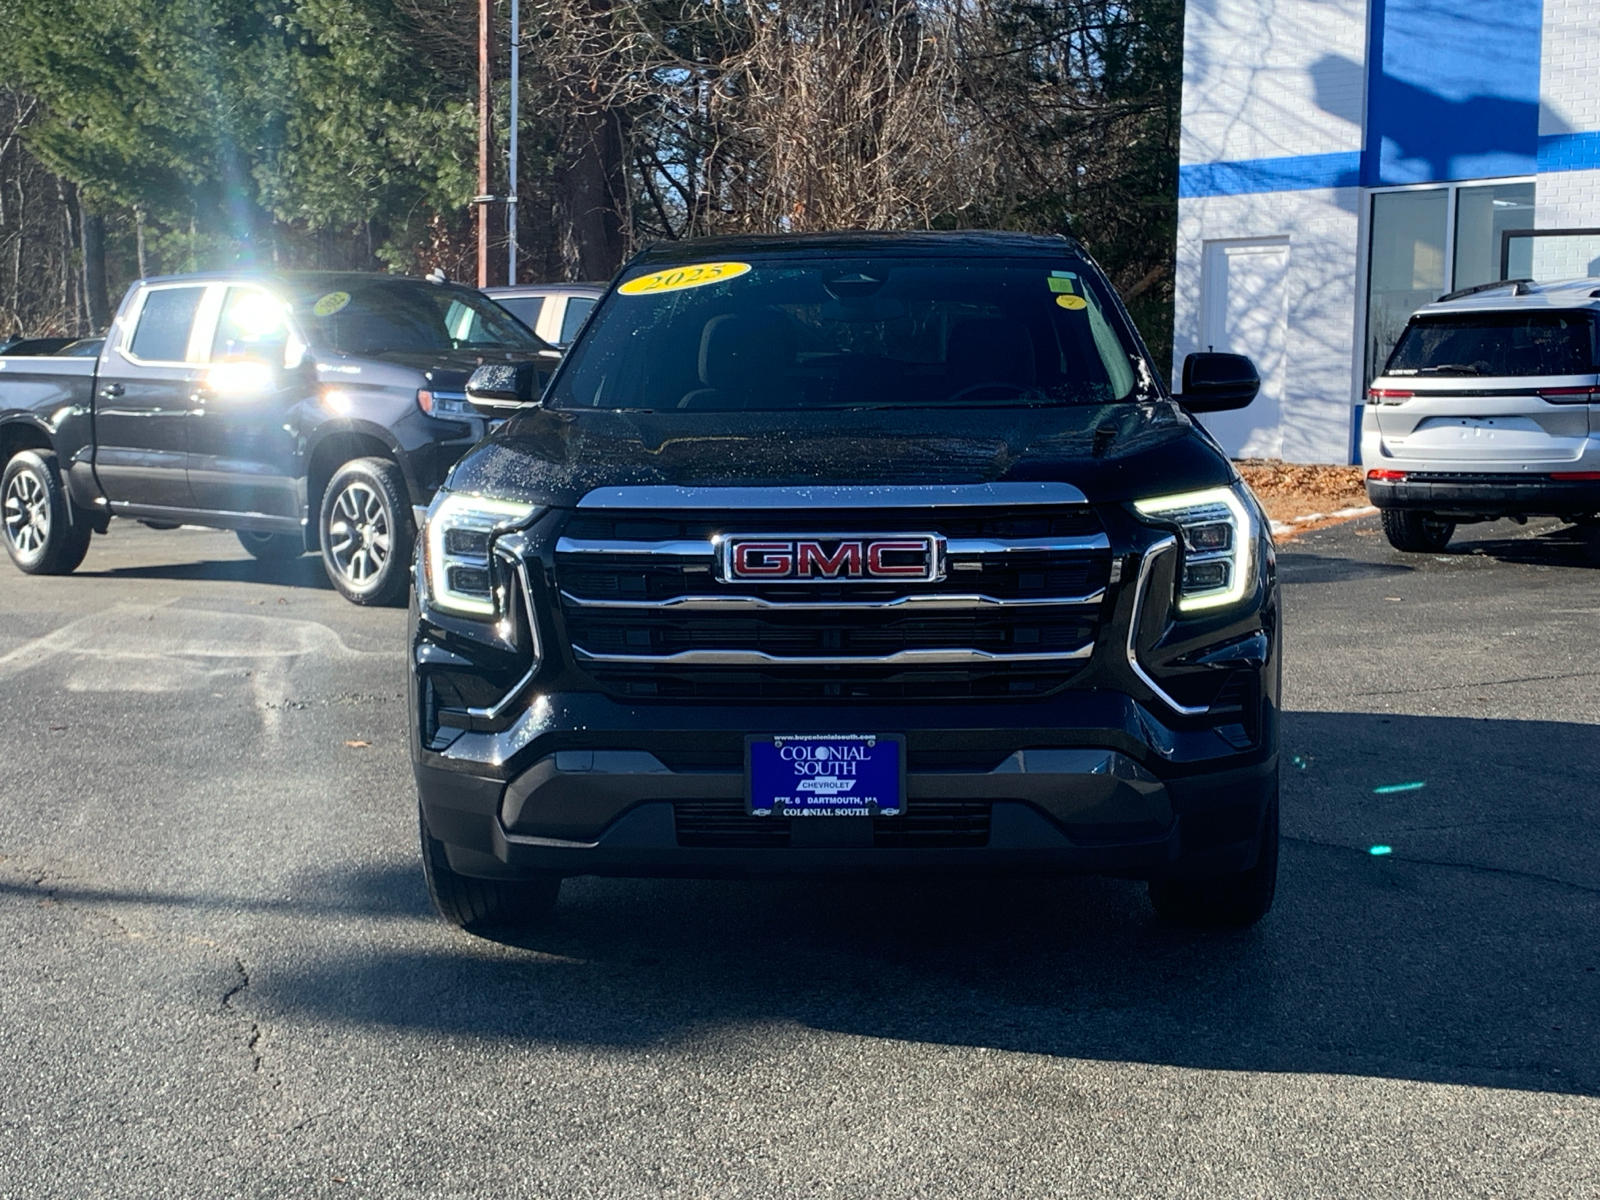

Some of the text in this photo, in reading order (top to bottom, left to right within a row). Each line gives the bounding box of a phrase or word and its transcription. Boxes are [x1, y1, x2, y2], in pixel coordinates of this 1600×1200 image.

[641, 263, 728, 291] 2025
[733, 541, 928, 576] GMC
[774, 733, 876, 741] www.buycolonialsouth.com
[780, 746, 872, 761] COLONIAL
[794, 761, 857, 775] SOUTH
[794, 797, 801, 805] 6
[807, 797, 863, 806] DARTMOUTH,
[783, 808, 870, 816] COLONIAL SOUTH
